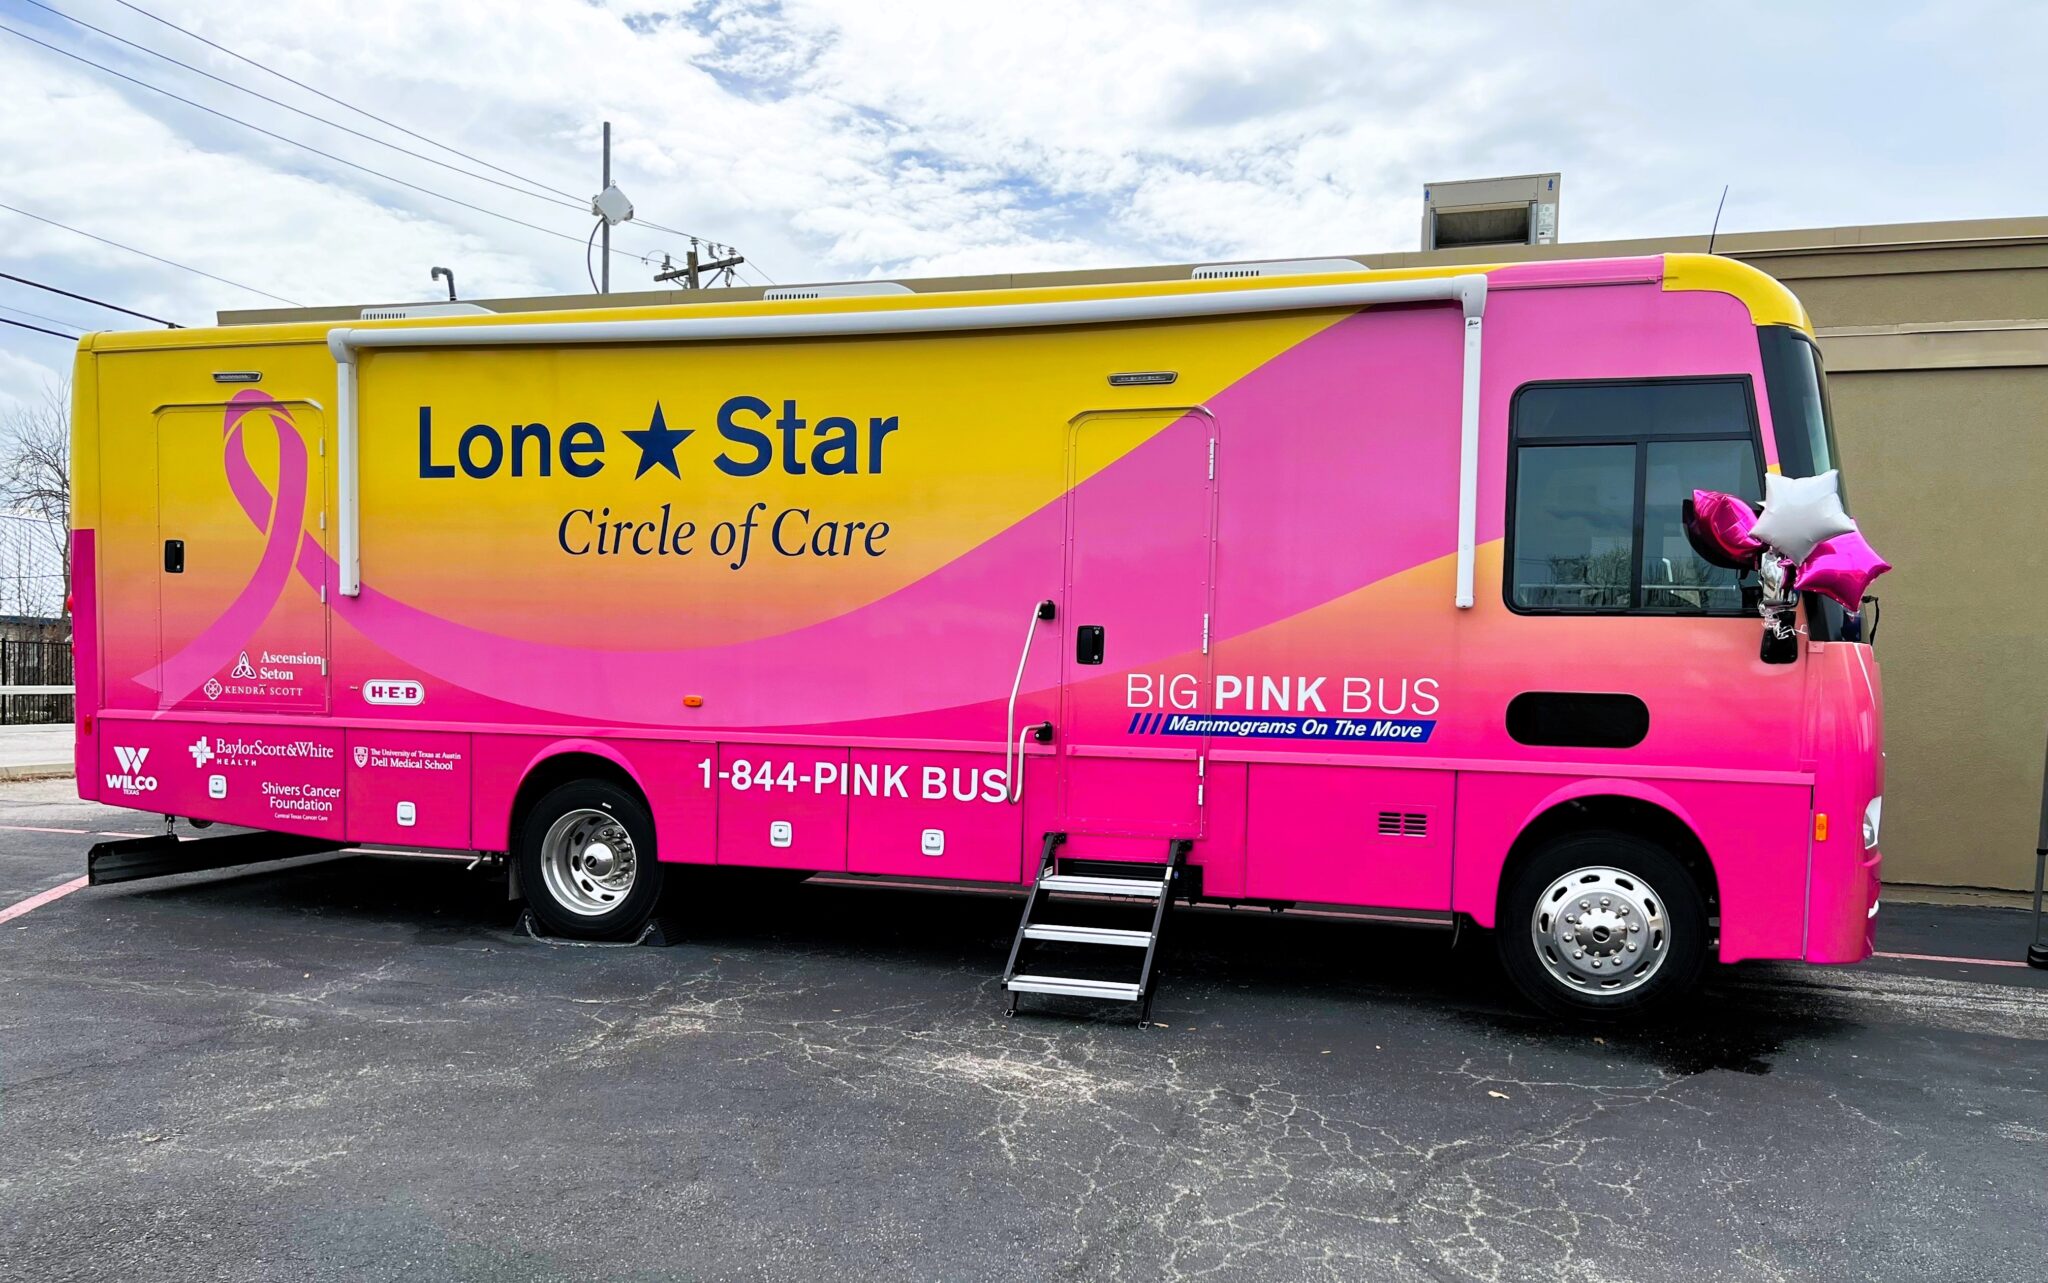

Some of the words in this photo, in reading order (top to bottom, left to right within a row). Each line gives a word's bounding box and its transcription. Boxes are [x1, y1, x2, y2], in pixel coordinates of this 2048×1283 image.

[419, 406, 606, 479] Lone
[713, 395, 899, 478] Star
[558, 503, 696, 556] Circle
[710, 502, 766, 571] of
[771, 508, 890, 557] Care
[260, 651, 322, 665] Ascension
[260, 667, 294, 680] Seton
[225, 685, 266, 695] KENDRA
[270, 687, 303, 696] SCOTT
[1127, 674, 1198, 709] BIG
[1215, 675, 1328, 712] PINK
[1343, 677, 1440, 715] BUS
[1169, 715, 1297, 737] Mammograms
[1301, 718, 1328, 736] On
[1333, 720, 1366, 737] The
[1370, 721, 1423, 738] Move
[381, 749, 410, 758] University
[216, 758, 257, 766] HEALTH
[371, 757, 388, 766] Dell
[390, 758, 422, 769] Medical
[424, 760, 453, 770] School
[105, 774, 158, 791] WILCO
[698, 758, 909, 798] 1-844-PINK
[922, 766, 1008, 803] BUS
[262, 782, 301, 796] Shivers
[302, 784, 341, 798] Cancer
[270, 796, 333, 811] Foundation
